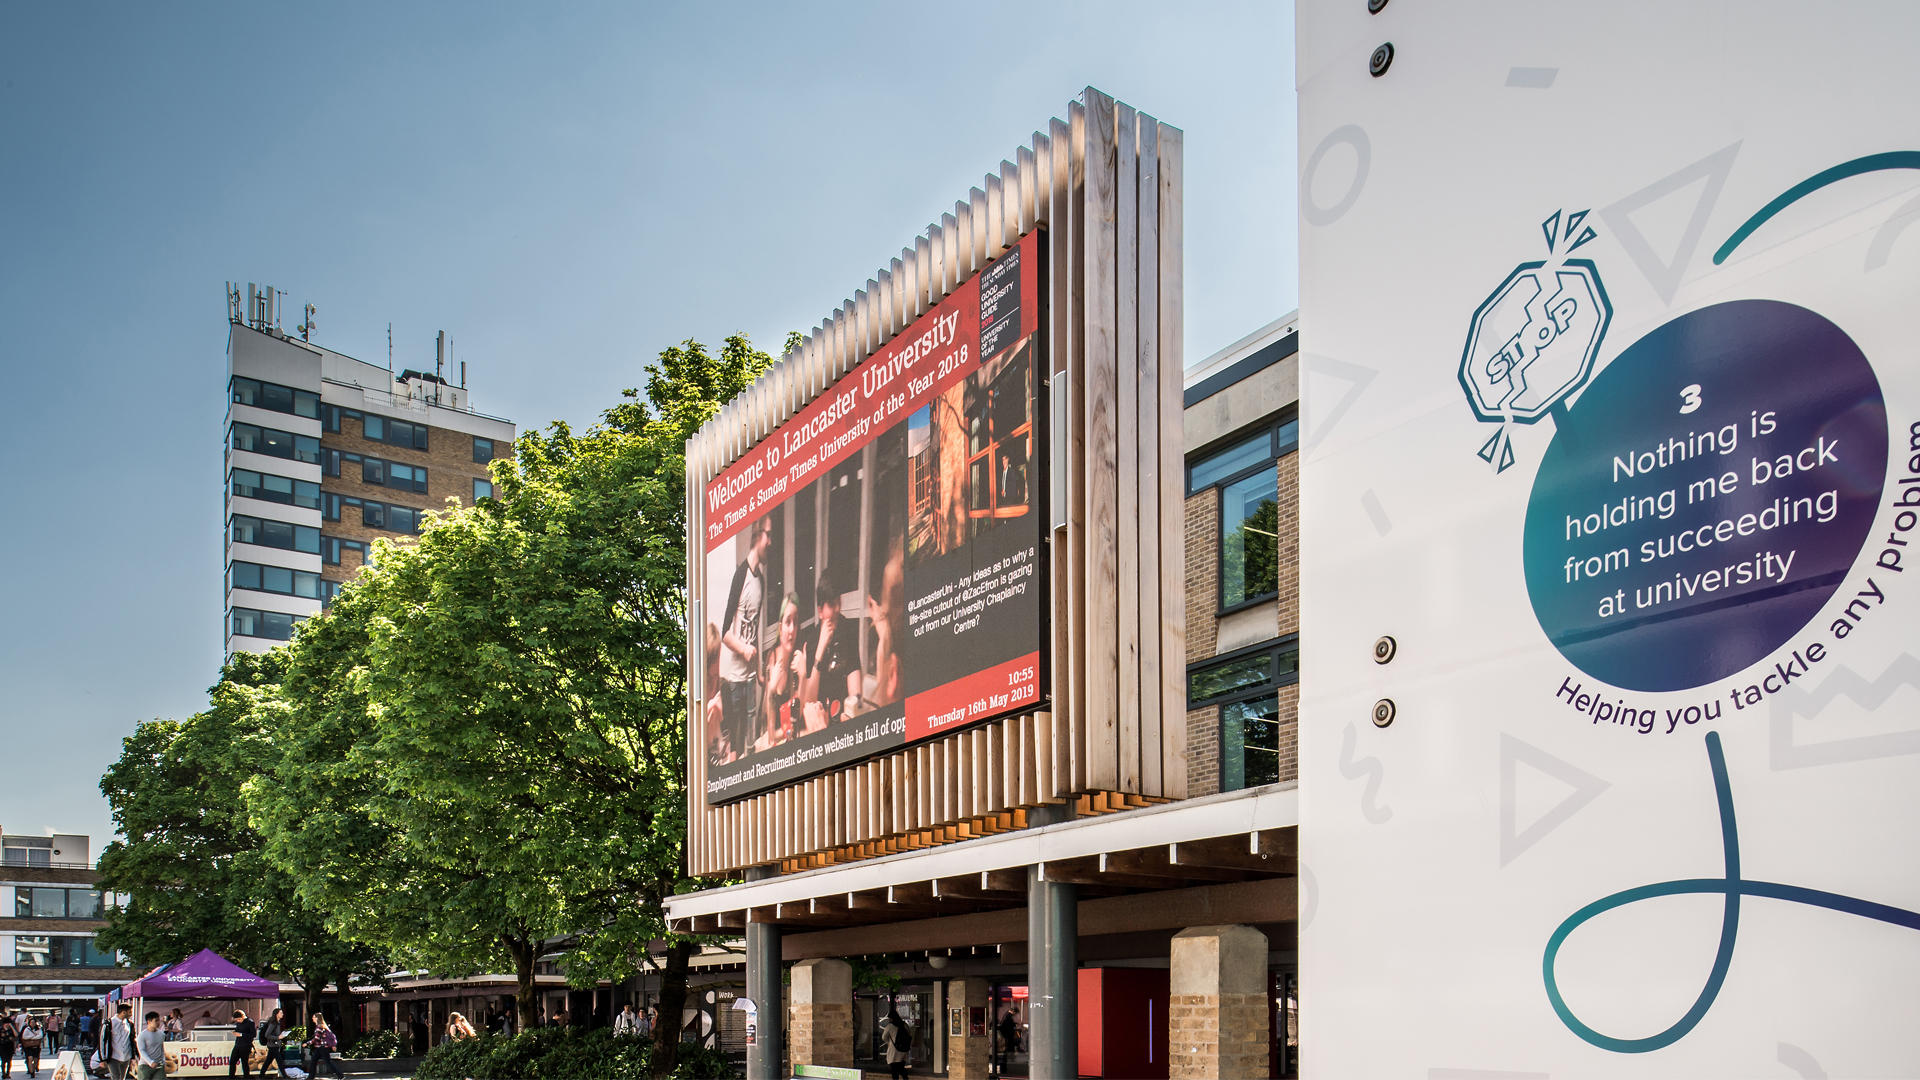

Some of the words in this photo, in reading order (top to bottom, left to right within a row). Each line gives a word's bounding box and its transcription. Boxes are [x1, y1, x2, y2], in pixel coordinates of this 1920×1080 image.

[981, 284, 998, 302] GOOD
[981, 281, 1014, 310] UNIVERSITY
[981, 302, 998, 320] GUIDE
[981, 315, 993, 329] 2018
[981, 319, 1009, 343] UNIVERSITY
[981, 342, 987, 351] OF
[989, 335, 998, 347] THE
[1486, 297, 1577, 385] STOP
[981, 344, 994, 358] YEAR
[709, 460, 763, 513] Welcome
[767, 447, 779, 470] to
[783, 386, 857, 459] Lancaster
[862, 309, 959, 399] University
[1679, 384, 1702, 414] 3
[709, 522, 722, 540] The
[724, 505, 747, 529] Times
[749, 497, 755, 512] &
[757, 475, 788, 506] Sunday
[790, 454, 817, 482] Times
[820, 415, 870, 462] University
[873, 401, 884, 425] of
[887, 392, 905, 415] the
[908, 371, 935, 400] Year
[938, 344, 968, 380] 2018
[1613, 423, 1738, 482] Nothing
[1751, 410, 1777, 438] is
[1566, 489, 1676, 540] holding
[1688, 471, 1739, 504] me
[1752, 436, 1838, 486] back
[1564, 548, 1629, 583] from
[1640, 490, 1838, 562] succeeding
[908, 582, 953, 612] @LancasterUni
[959, 576, 971, 589] Any
[973, 566, 991, 582] ideas
[993, 562, 1001, 573] as
[1003, 558, 1010, 568] to
[1012, 549, 1027, 564] why
[1029, 547, 1034, 557] a
[909, 608, 932, 625] life-size
[933, 597, 953, 615] cutout
[954, 593, 961, 606] of
[962, 579, 998, 601] @ZacEfron
[1000, 574, 1006, 585] is
[1008, 563, 1032, 584] gazing
[1598, 589, 1626, 618] at
[1636, 550, 1796, 609] university
[914, 625, 924, 637] out
[925, 619, 939, 632] from
[941, 613, 952, 626] our
[953, 599, 985, 621] University
[986, 582, 1026, 606] Chaplaincy
[954, 614, 980, 634] Centre?
[1008, 666, 1033, 685] 10:55
[1555, 676, 1656, 734] Helping
[1665, 700, 1721, 734] you
[1730, 642, 1827, 711] tackle
[1830, 577, 1885, 640] any
[927, 707, 966, 728] Thursday
[968, 698, 987, 716] 16th
[989, 693, 1008, 709] May
[1011, 684, 1034, 702] 2019
[707, 771, 742, 793] Employment
[743, 765, 755, 781] and
[756, 752, 795, 777] Recruitment
[797, 744, 823, 764] Service
[824, 734, 854, 754] website
[856, 730, 862, 744] is
[865, 722, 879, 741] full
[880, 718, 889, 735] of
[180, 1053, 240, 1069] Doughnu
